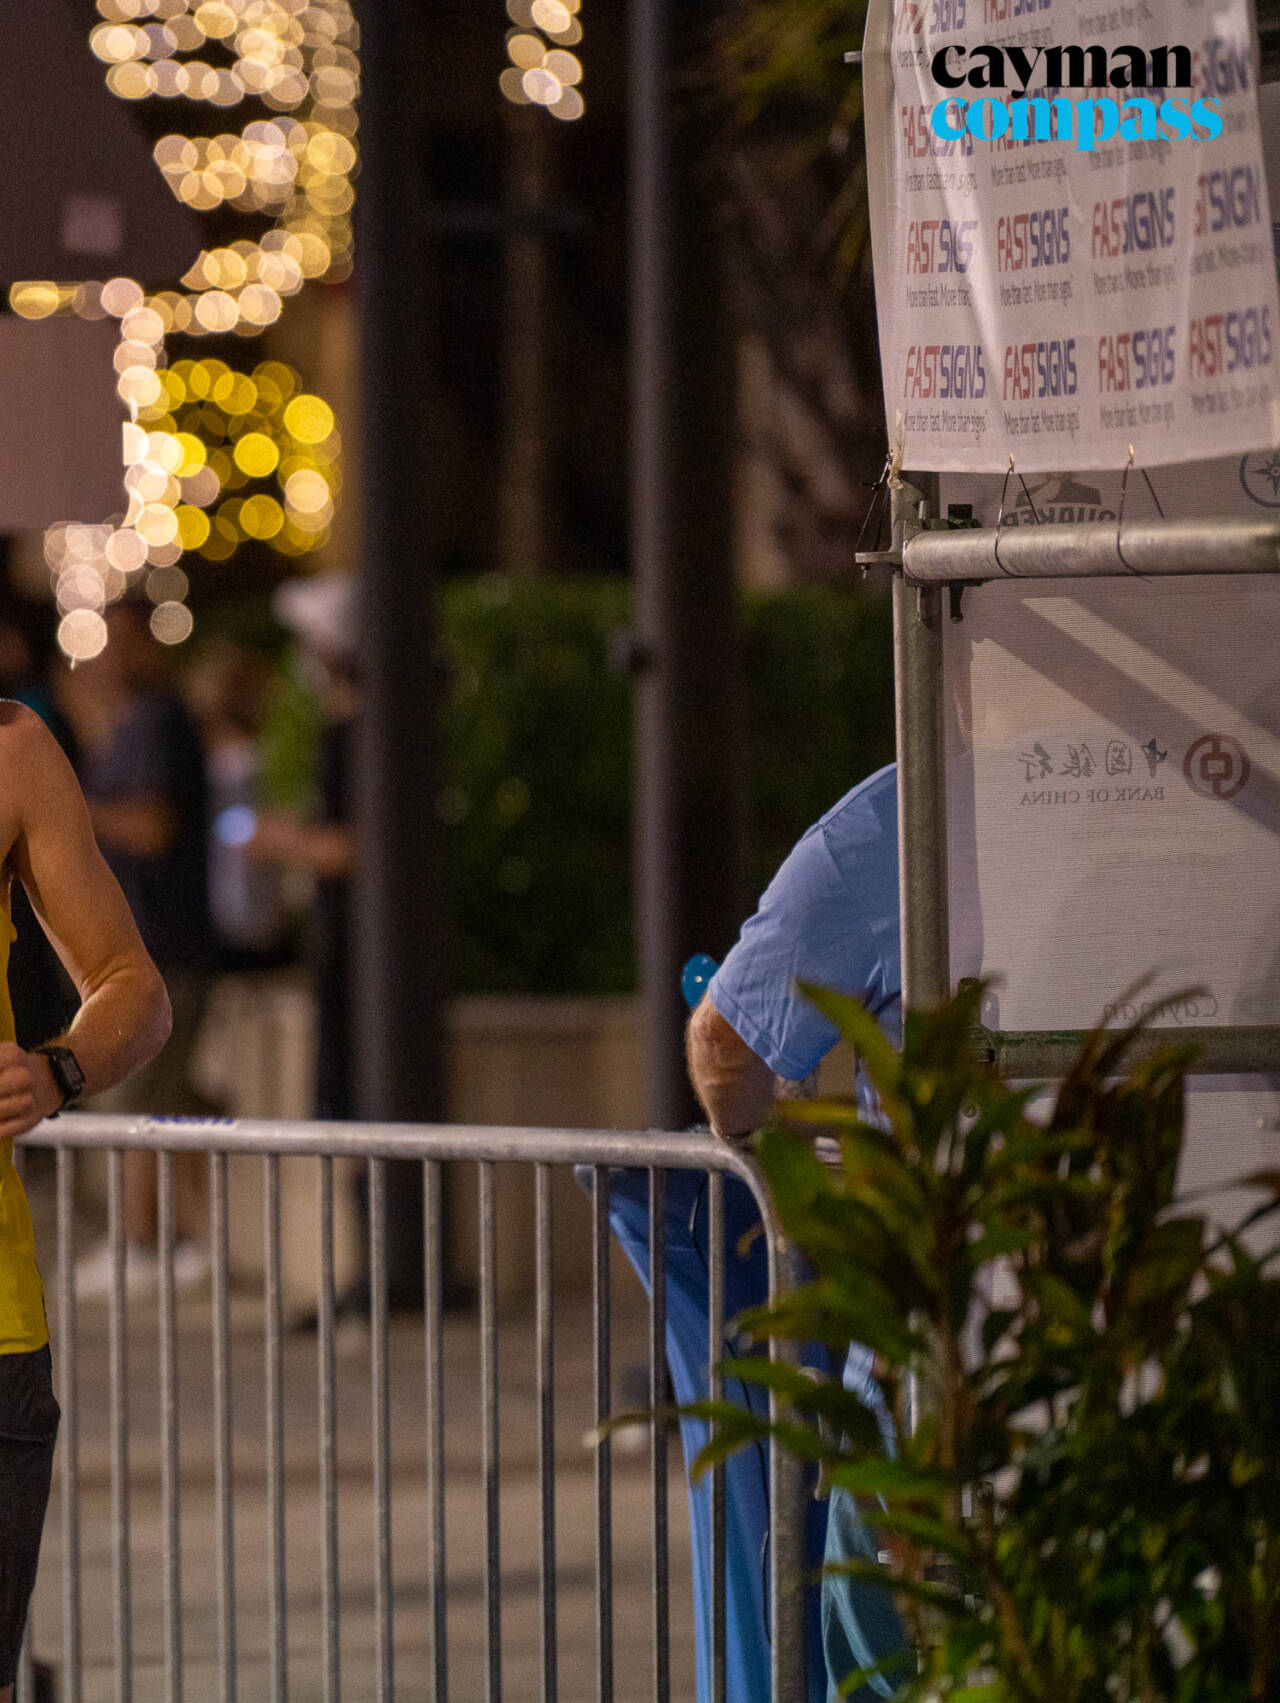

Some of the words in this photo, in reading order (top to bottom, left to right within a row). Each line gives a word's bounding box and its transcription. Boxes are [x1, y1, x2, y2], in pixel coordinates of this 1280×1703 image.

[997, 207, 1070, 272] FASTSIGNS
[903, 344, 986, 399] FASTSIGNS
[1003, 338, 1077, 401] FASTSIGNS
